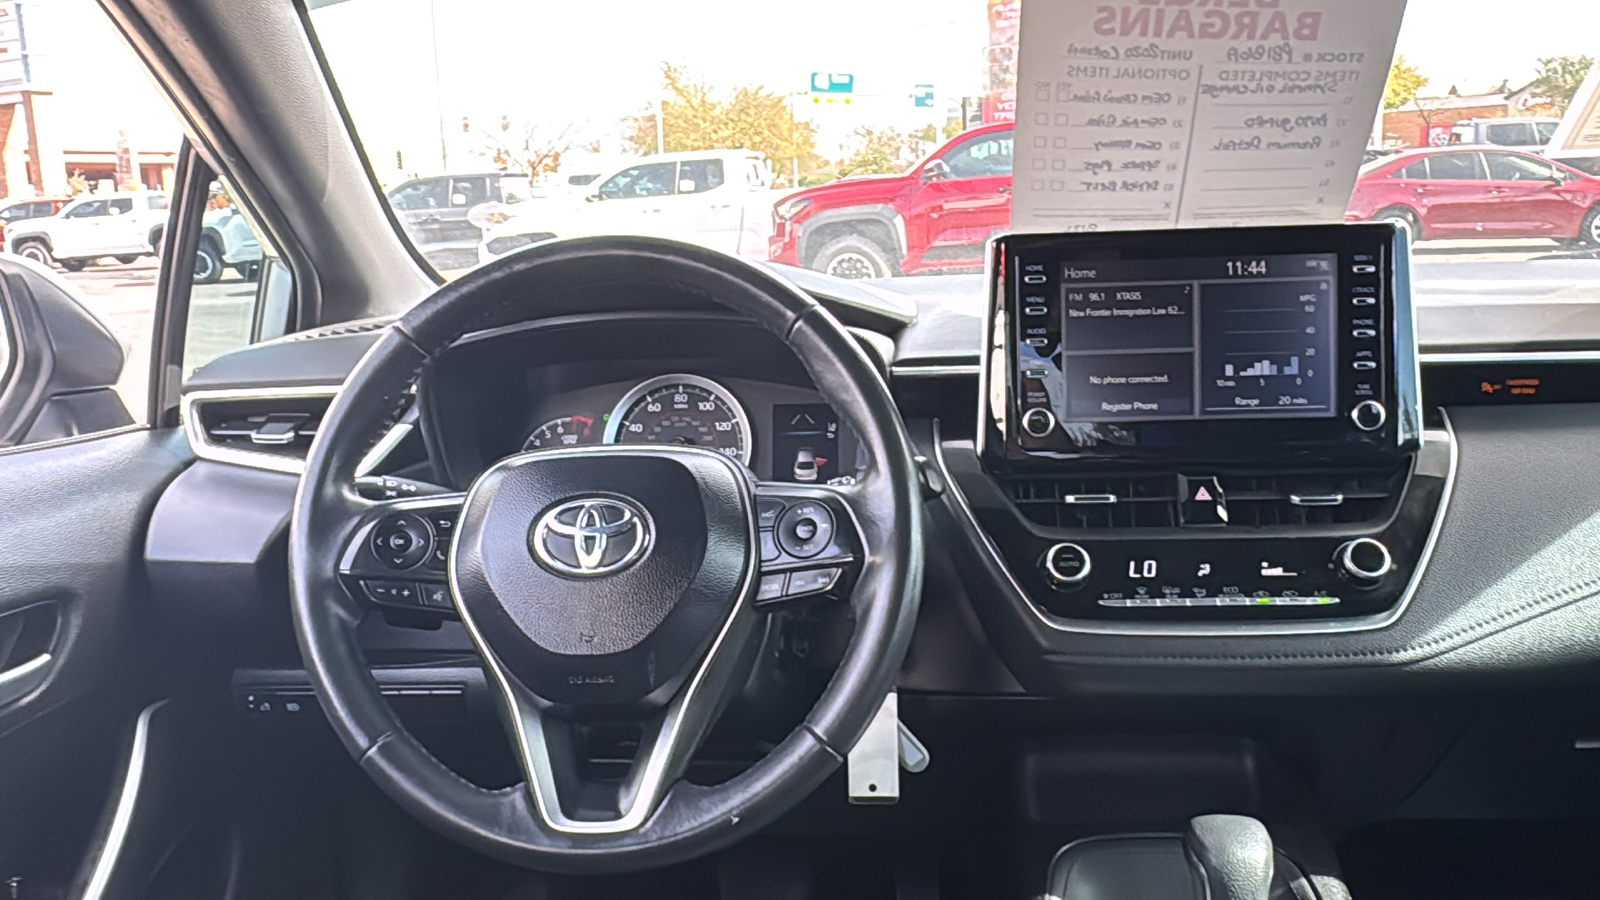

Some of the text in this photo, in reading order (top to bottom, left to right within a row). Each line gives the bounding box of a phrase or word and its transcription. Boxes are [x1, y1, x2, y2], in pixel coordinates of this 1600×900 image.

[1226, 260, 1267, 276] 11:44
[1064, 267, 1097, 279] Home
[1069, 292, 1142, 302] FM 96.1 XTASIS
[1069, 309, 1085, 317] New
[1086, 308, 1112, 317] Frontier
[1113, 307, 1151, 317] Immigration
[1152, 306, 1166, 315] Law
[1304, 305, 1315, 313] 60
[1305, 326, 1316, 334] 40
[1305, 348, 1316, 356] 20
[1089, 376, 1101, 384] No
[1103, 376, 1127, 386] phone
[673, 394, 688, 403] 80
[1235, 397, 1260, 407] Range
[1278, 396, 1291, 405] 20
[647, 403, 662, 412] 60
[698, 402, 715, 411] 100
[1102, 402, 1158, 413] Register Phone
[629, 424, 643, 433] 40
[715, 422, 732, 431] 120
[1128, 560, 1157, 578] LO
